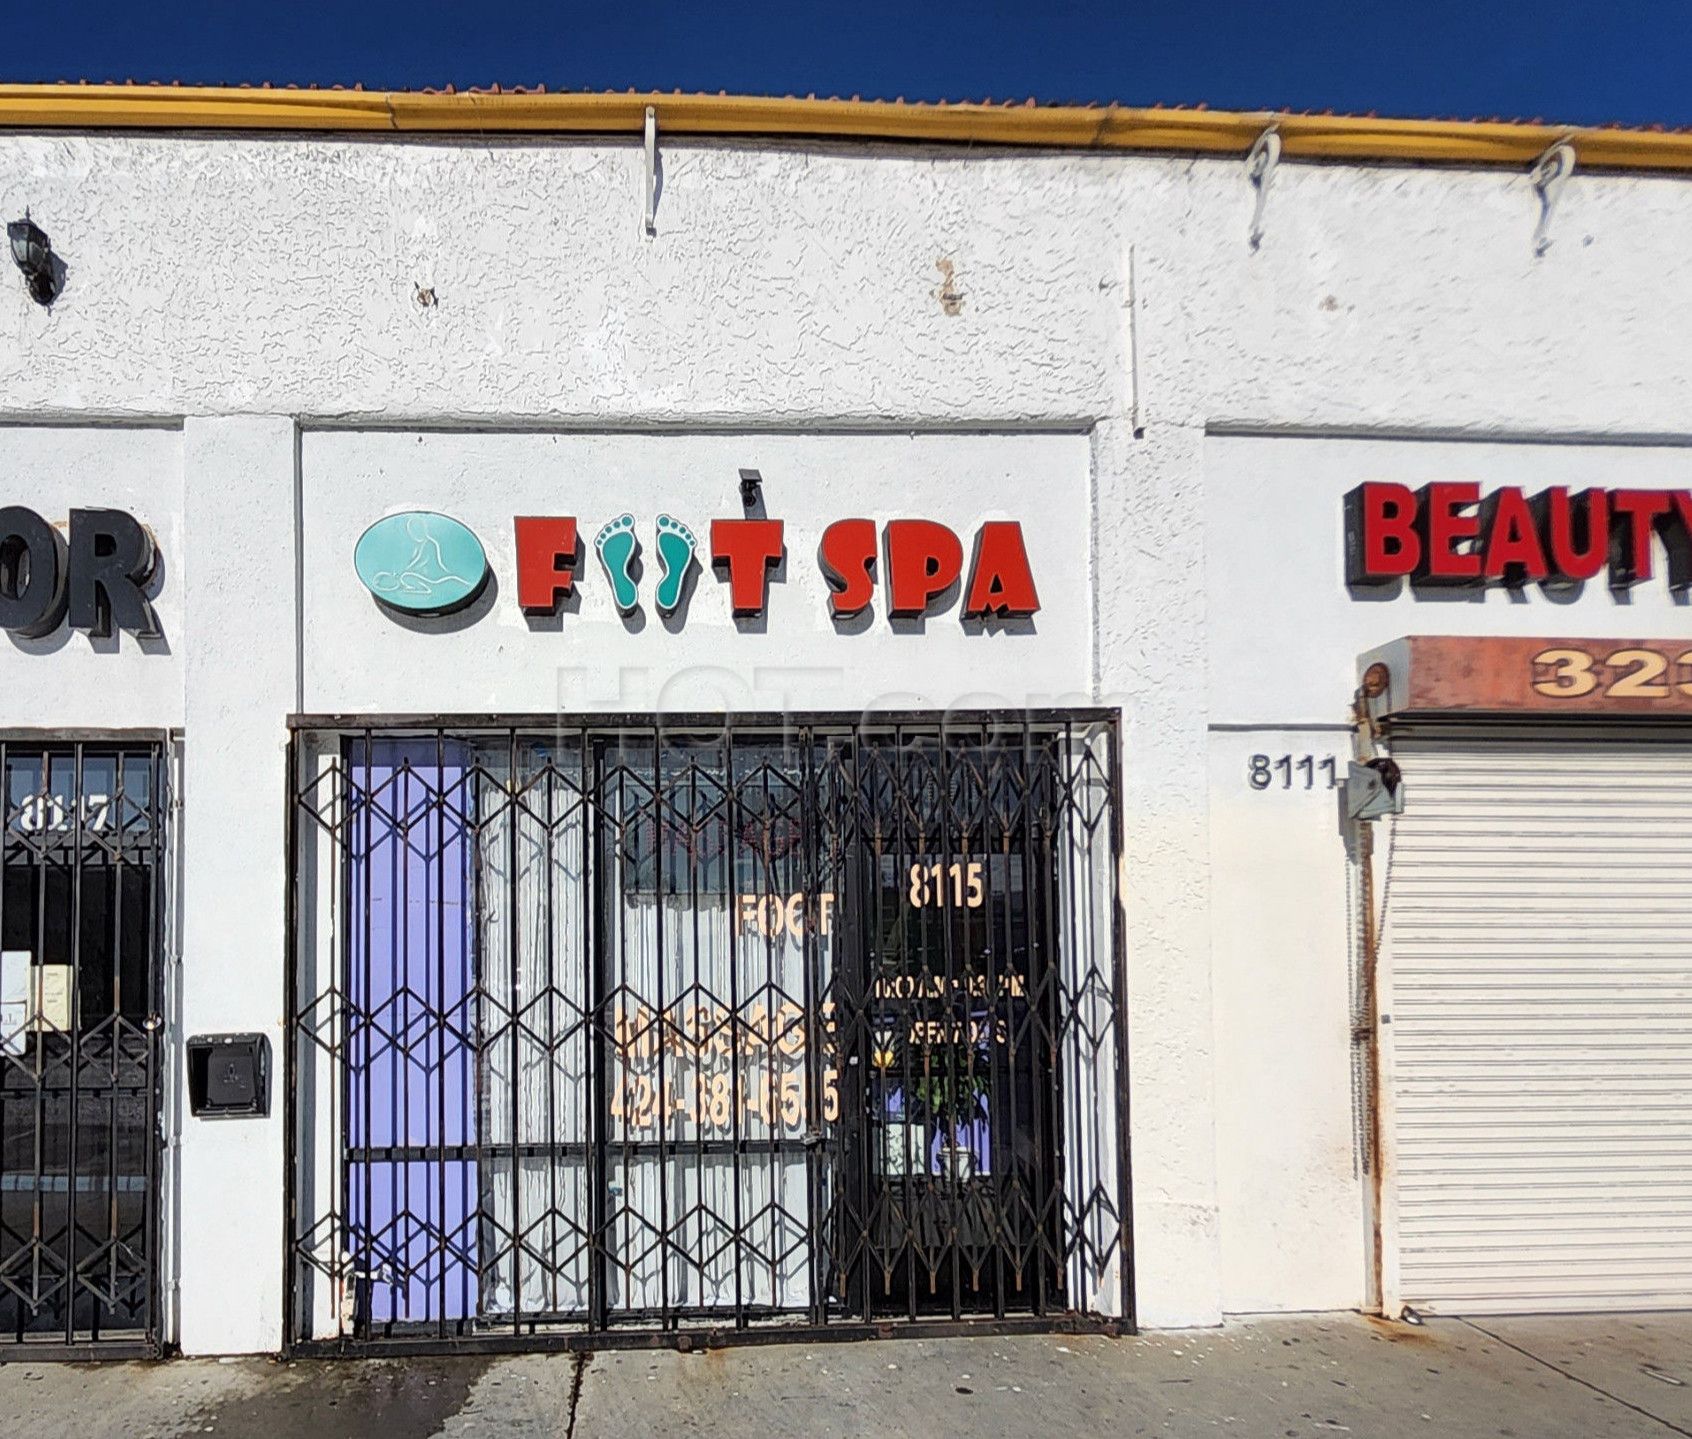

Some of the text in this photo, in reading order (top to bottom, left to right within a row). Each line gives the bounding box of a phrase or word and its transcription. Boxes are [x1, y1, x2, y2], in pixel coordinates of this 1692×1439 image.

[817, 517, 1041, 614] SPA
[1362, 481, 1692, 580] BEAUT
[1248, 754, 1339, 790] 8111
[909, 862, 985, 908] 8115
